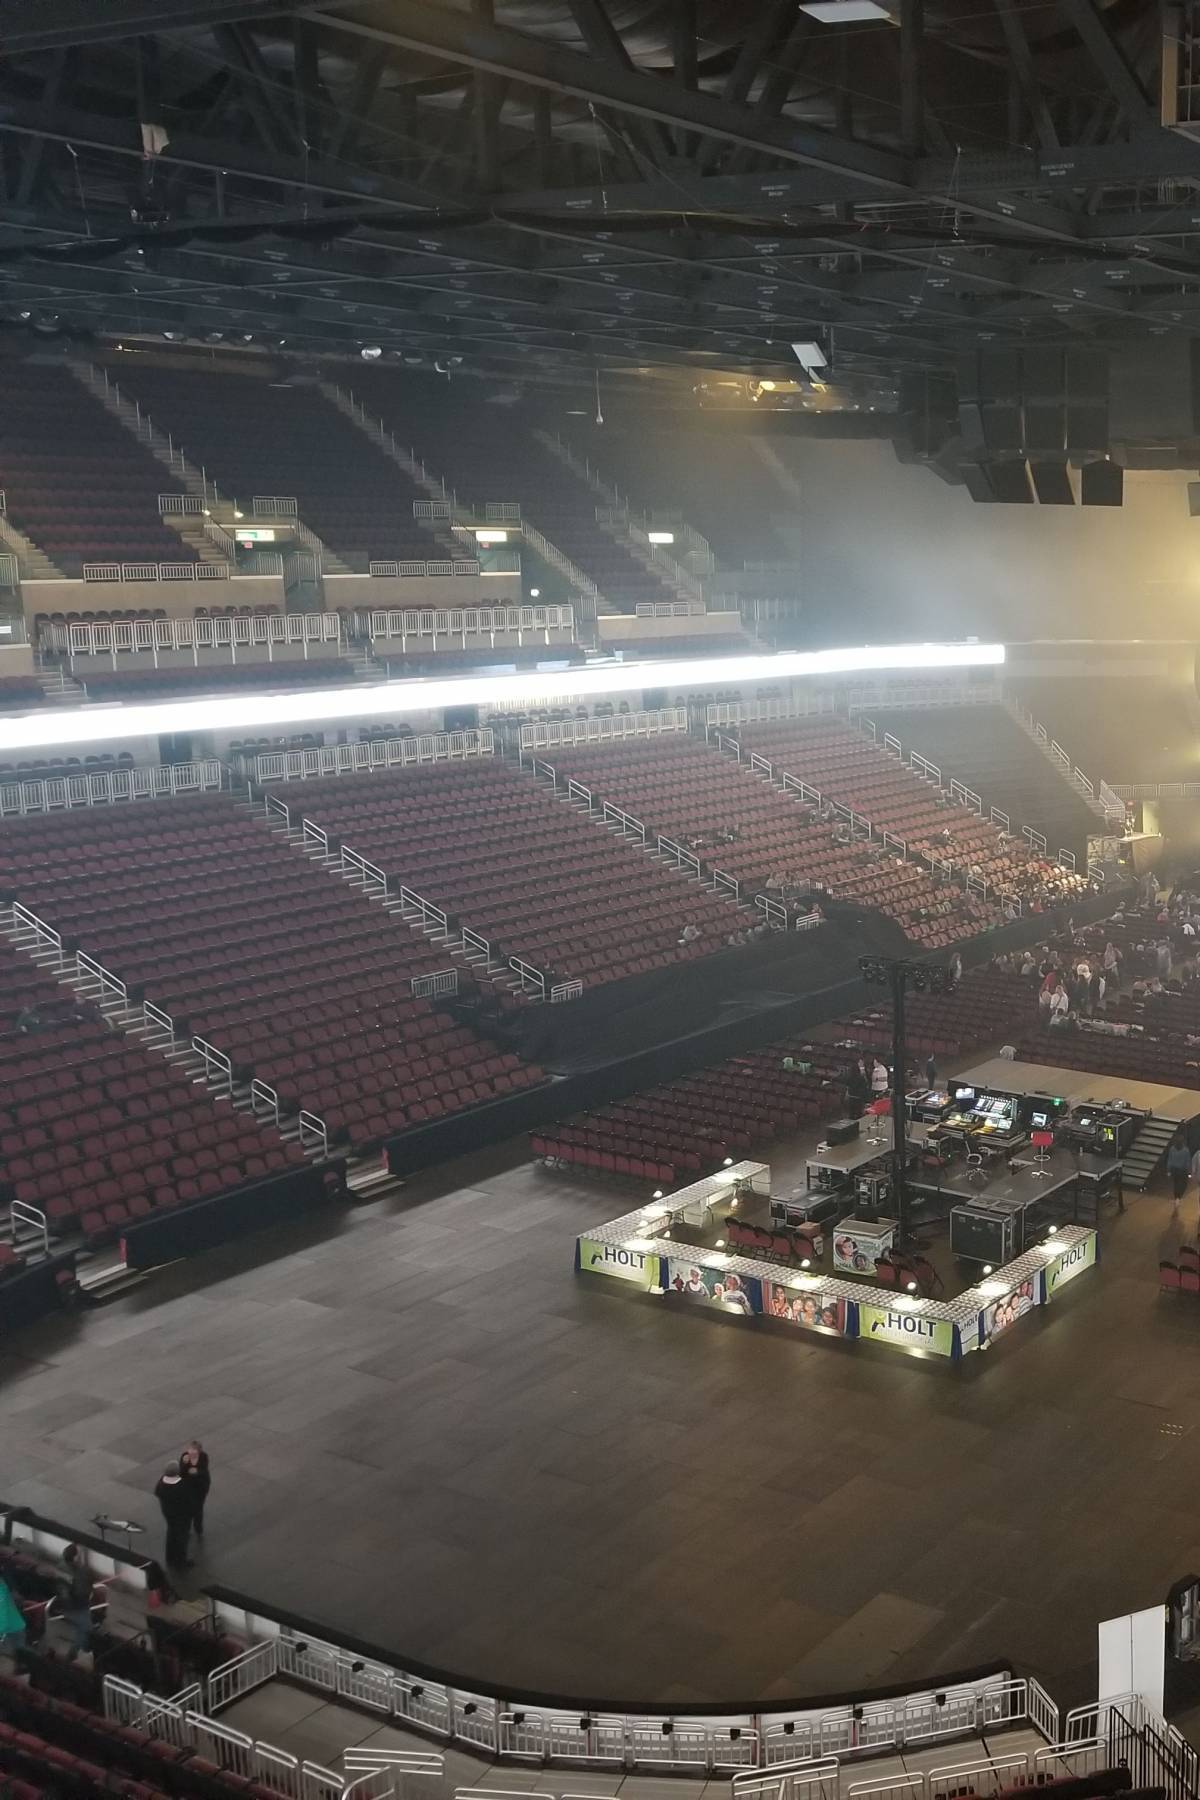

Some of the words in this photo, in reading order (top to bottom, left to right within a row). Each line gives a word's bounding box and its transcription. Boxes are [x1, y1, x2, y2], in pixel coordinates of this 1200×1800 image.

[604, 1246, 646, 1269] HOLT
[1061, 1241, 1088, 1272] HOLT
[888, 1312, 937, 1337] HOLT
